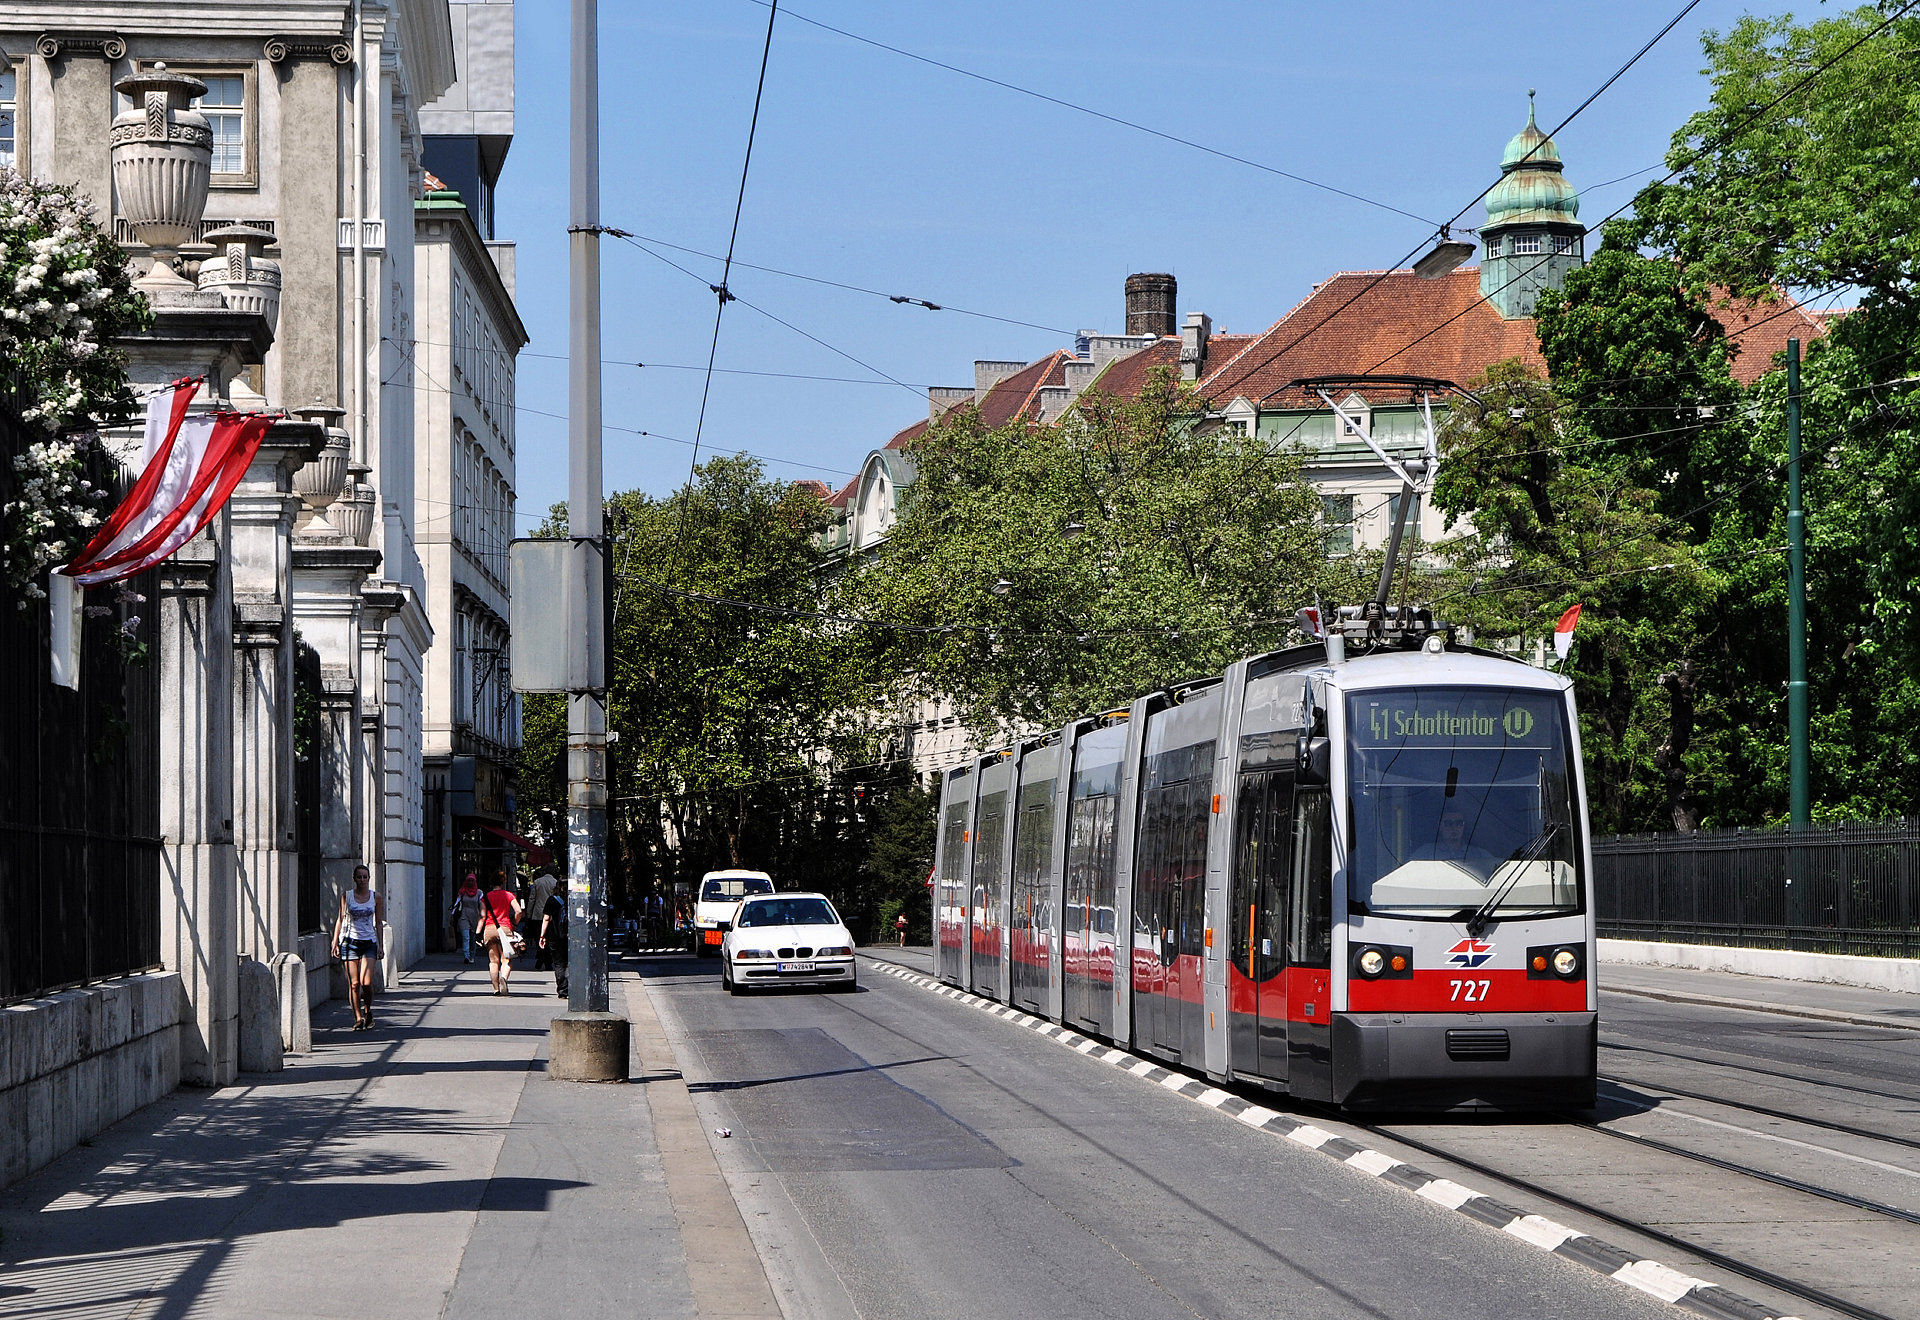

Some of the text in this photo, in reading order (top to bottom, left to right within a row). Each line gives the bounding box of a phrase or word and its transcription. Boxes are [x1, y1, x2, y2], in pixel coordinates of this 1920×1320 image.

[1370, 708, 1389, 740] 41
[1394, 710, 1497, 736] Schottentor
[1450, 979, 1491, 1002] 727
